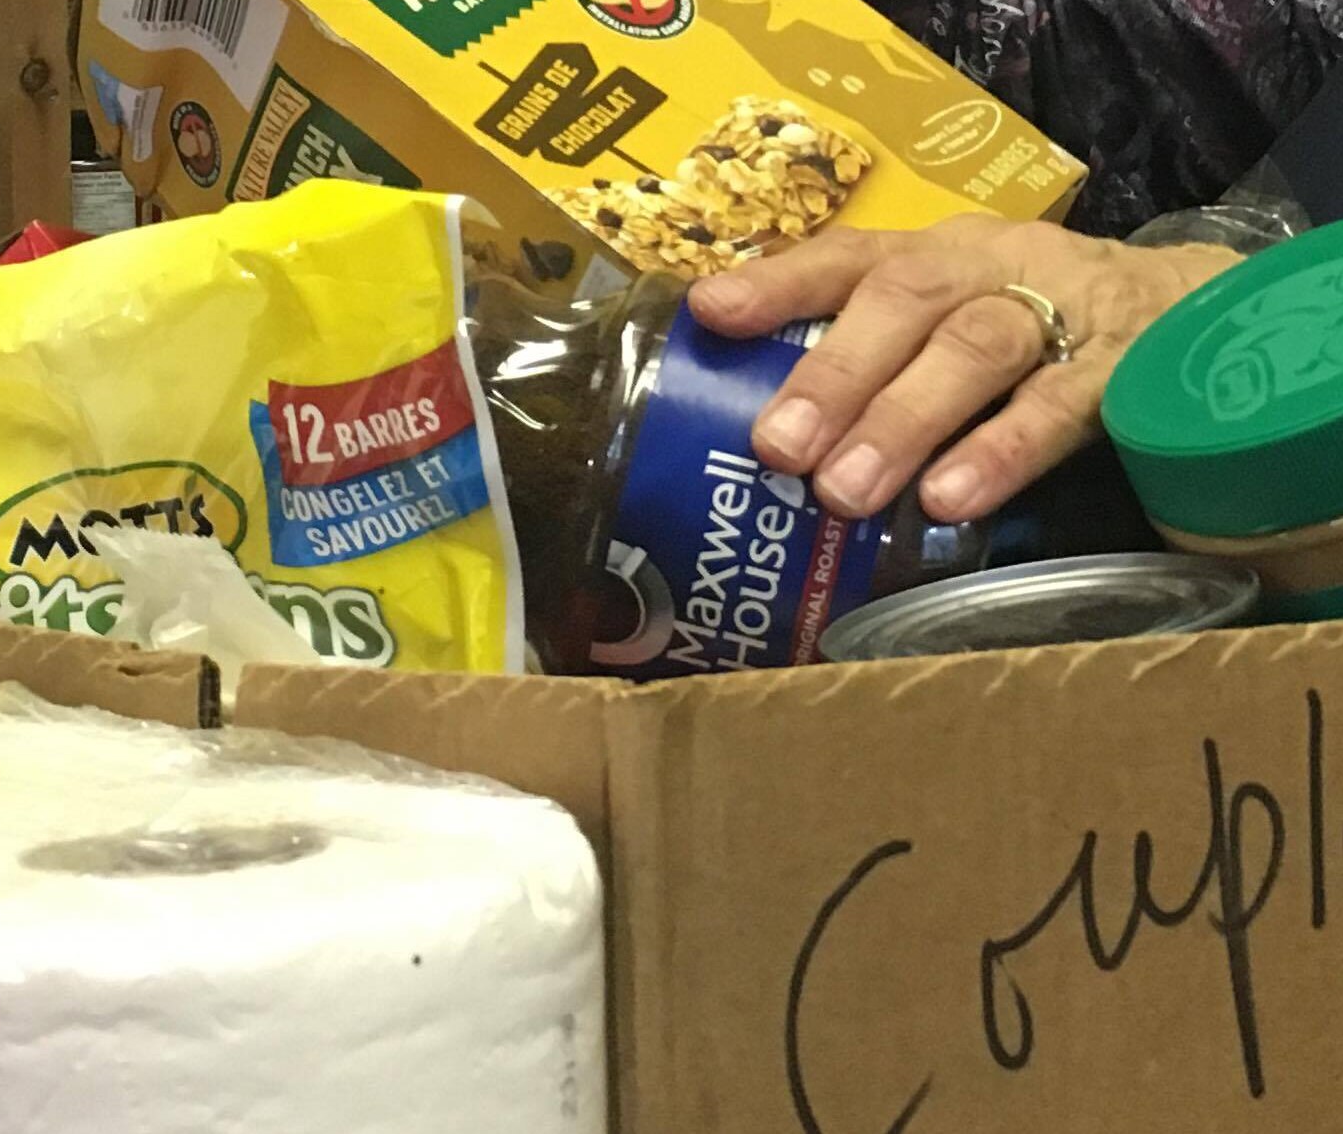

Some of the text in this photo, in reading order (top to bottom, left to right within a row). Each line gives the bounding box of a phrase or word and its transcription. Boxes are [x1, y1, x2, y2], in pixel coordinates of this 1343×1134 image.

[262, 88, 304, 139] VALLEY
[502, 58, 581, 141] GRAINS DE
[553, 86, 638, 156] CHOCOLAT
[979, 136, 1039, 187] BARRES
[284, 398, 442, 466] 12 BARRES
[280, 454, 452, 522] CONGELEZ ET
[306, 495, 456, 558] SAVOUREZ
[666, 449, 758, 667] Maxwell
[814, 517, 846, 580] ROAST
[716, 505, 795, 672] House
